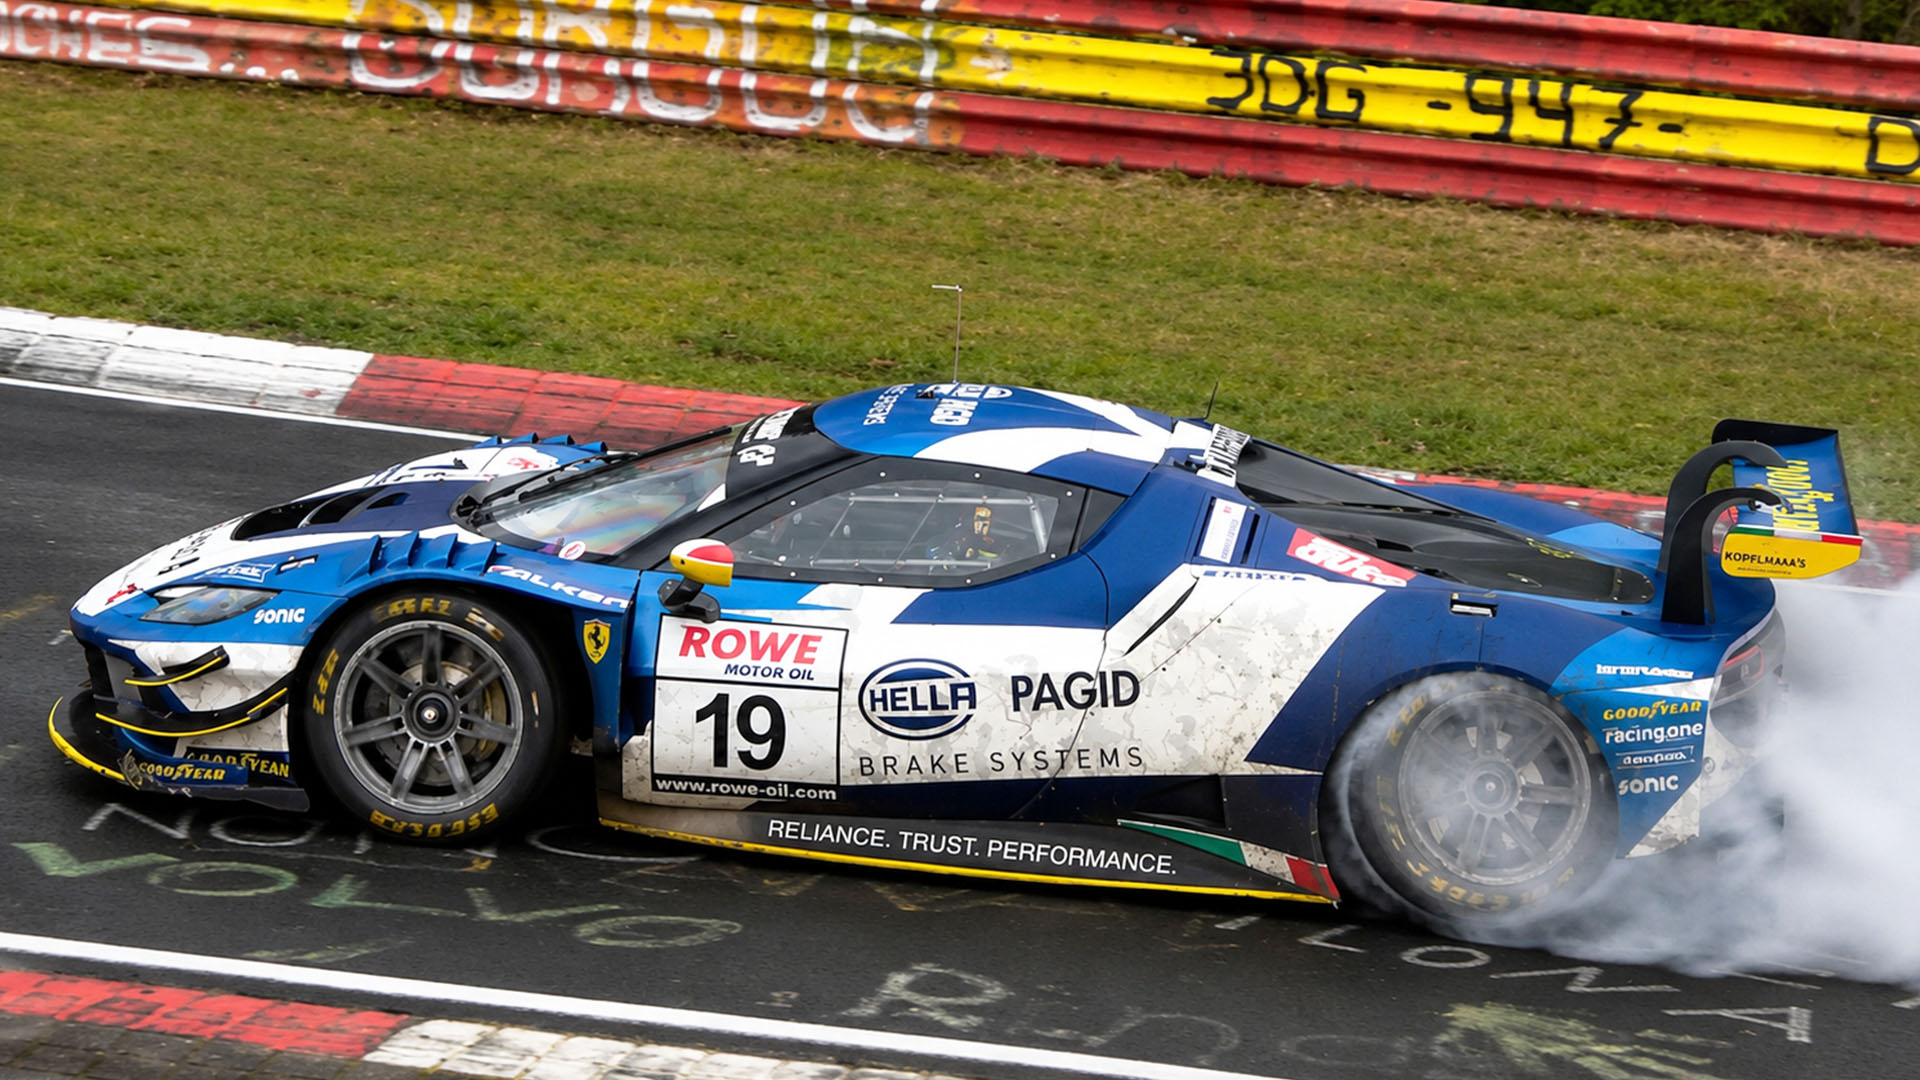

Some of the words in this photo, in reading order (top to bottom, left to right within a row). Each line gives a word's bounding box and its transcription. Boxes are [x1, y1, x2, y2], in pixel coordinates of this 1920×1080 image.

[678, 625, 823, 665] ROWE
[723, 663, 784, 679] MOTOR
[788, 667, 815, 681] OIL
[869, 681, 977, 712] HELLA
[1010, 670, 1141, 712] PAGID
[1602, 700, 1702, 720] GOODYEAR
[695, 693, 787, 771] 19
[859, 753, 970, 776] BRAKE
[990, 747, 1143, 772] SYSTEMS
[655, 778, 837, 800] www.rowe-oil.com
[767, 819, 891, 848] RELIANCE.
[899, 831, 980, 857] TRUST.
[986, 841, 1177, 875] PERFORMANCE.
[10, 841, 744, 949] VOLVO
